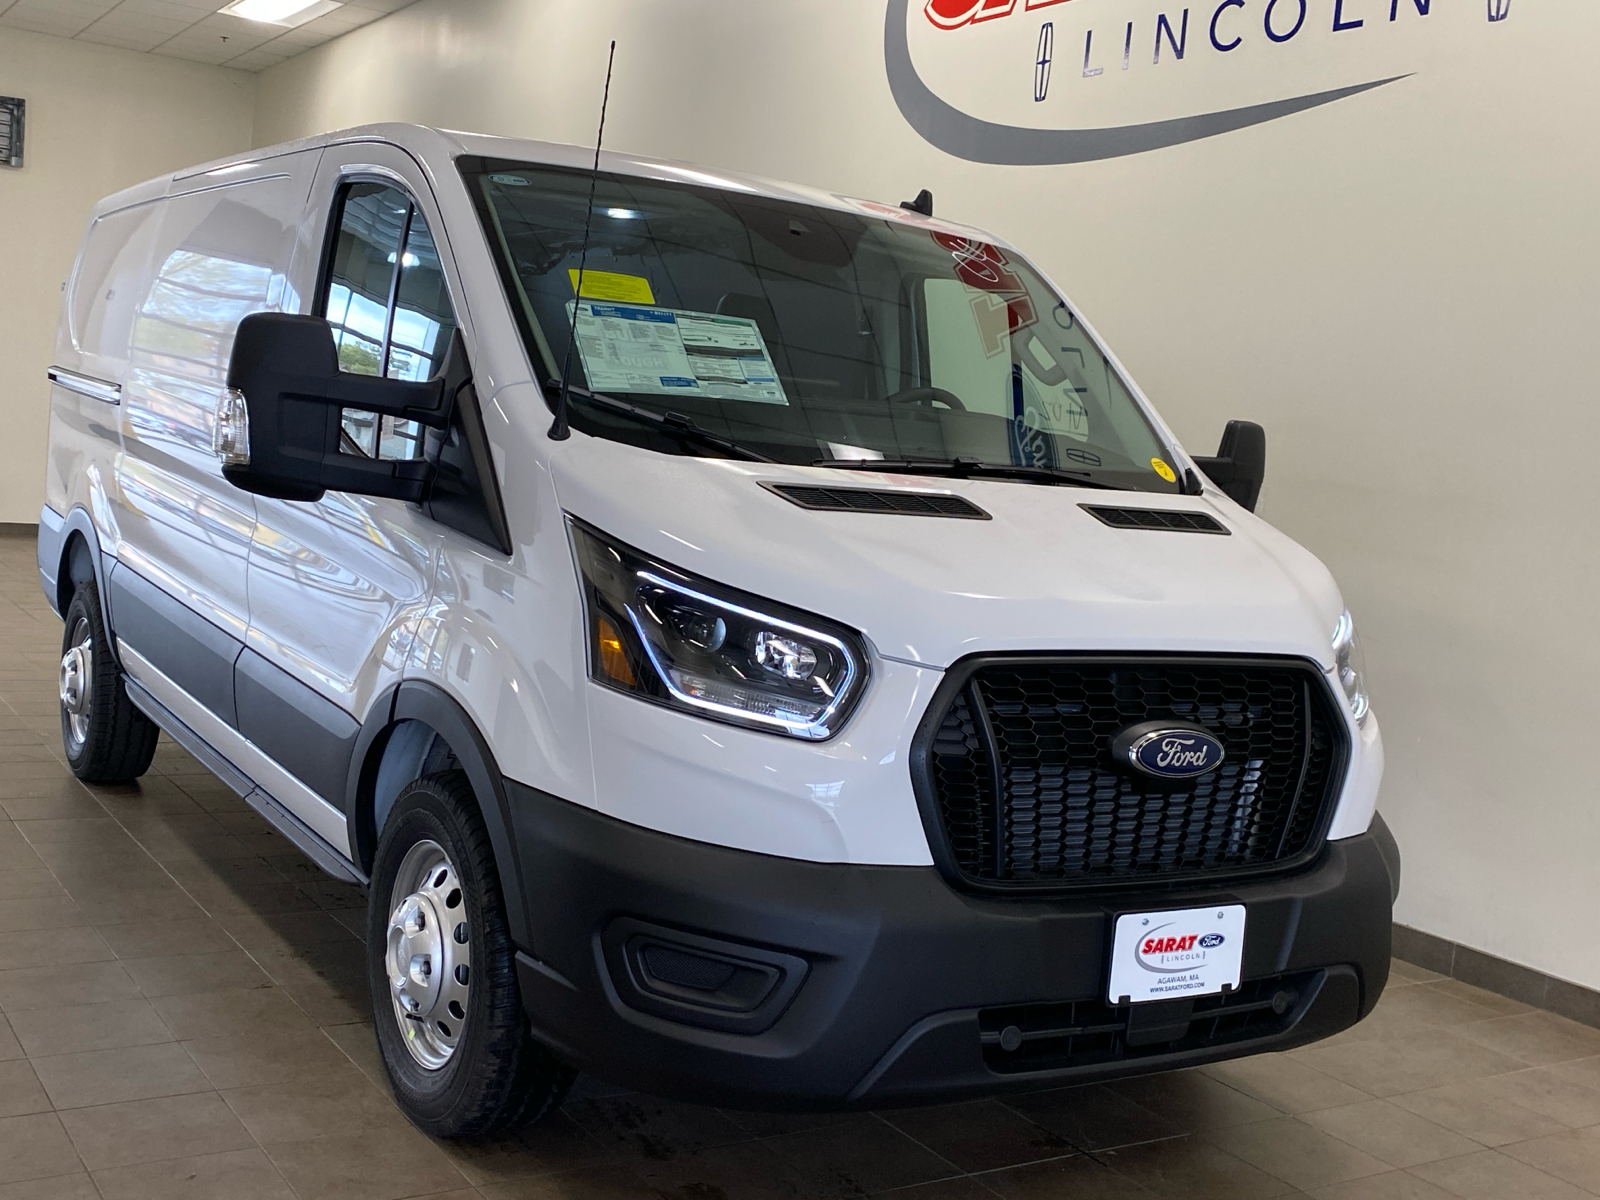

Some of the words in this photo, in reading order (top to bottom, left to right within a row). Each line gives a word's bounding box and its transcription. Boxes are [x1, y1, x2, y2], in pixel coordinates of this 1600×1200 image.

[1156, 738, 1208, 767] Ford
[1141, 934, 1199, 955] SARAT
[1202, 935, 1221, 947] Ford
[1166, 952, 1201, 962] LINCOLN
[1157, 975, 1188, 984] AGAWAM,
[1189, 973, 1200, 981] MA
[1149, 981, 1205, 993] WWW.SARATFORD.COM
